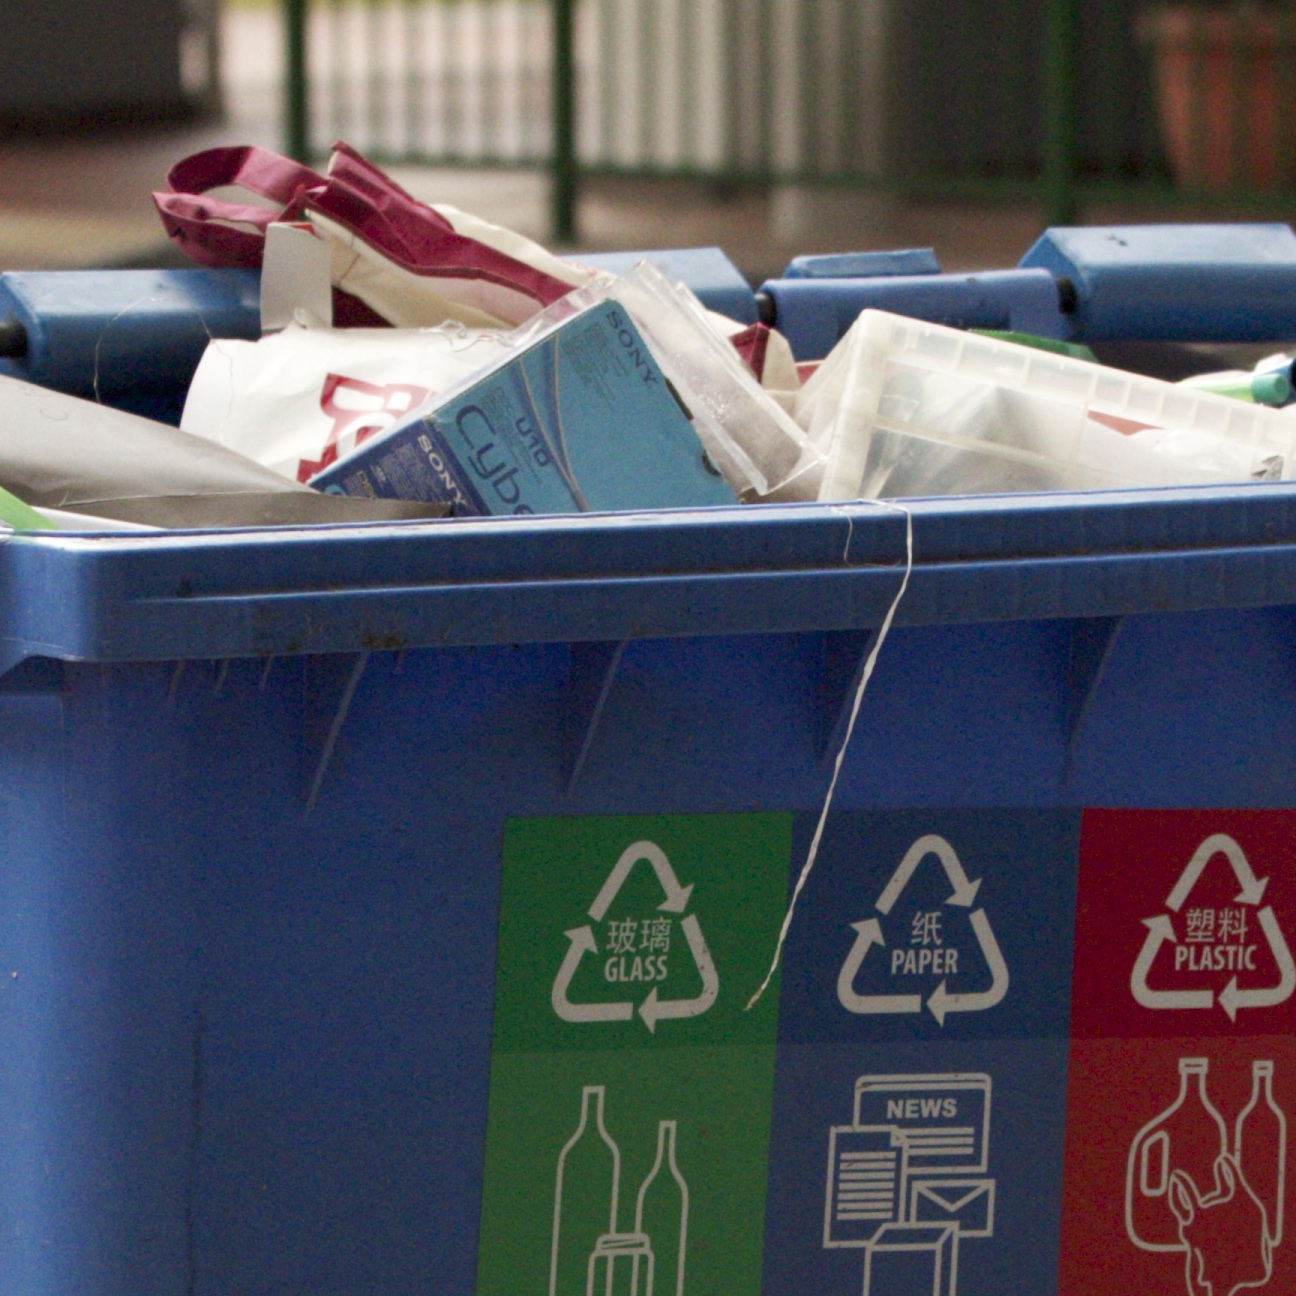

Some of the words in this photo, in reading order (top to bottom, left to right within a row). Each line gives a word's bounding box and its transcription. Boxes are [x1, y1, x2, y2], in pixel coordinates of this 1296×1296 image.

[606, 311, 656, 385] SONY
[417, 434, 467, 507] SONY
[607, 916, 672, 954] 玻璃
[911, 912, 942, 946] 纸
[1185, 908, 1248, 943] 塑料
[604, 955, 668, 983] GLASS
[891, 948, 958, 976] PAPER
[1174, 944, 1256, 972] PLASTIC
[886, 1098, 958, 1120] NEWS
